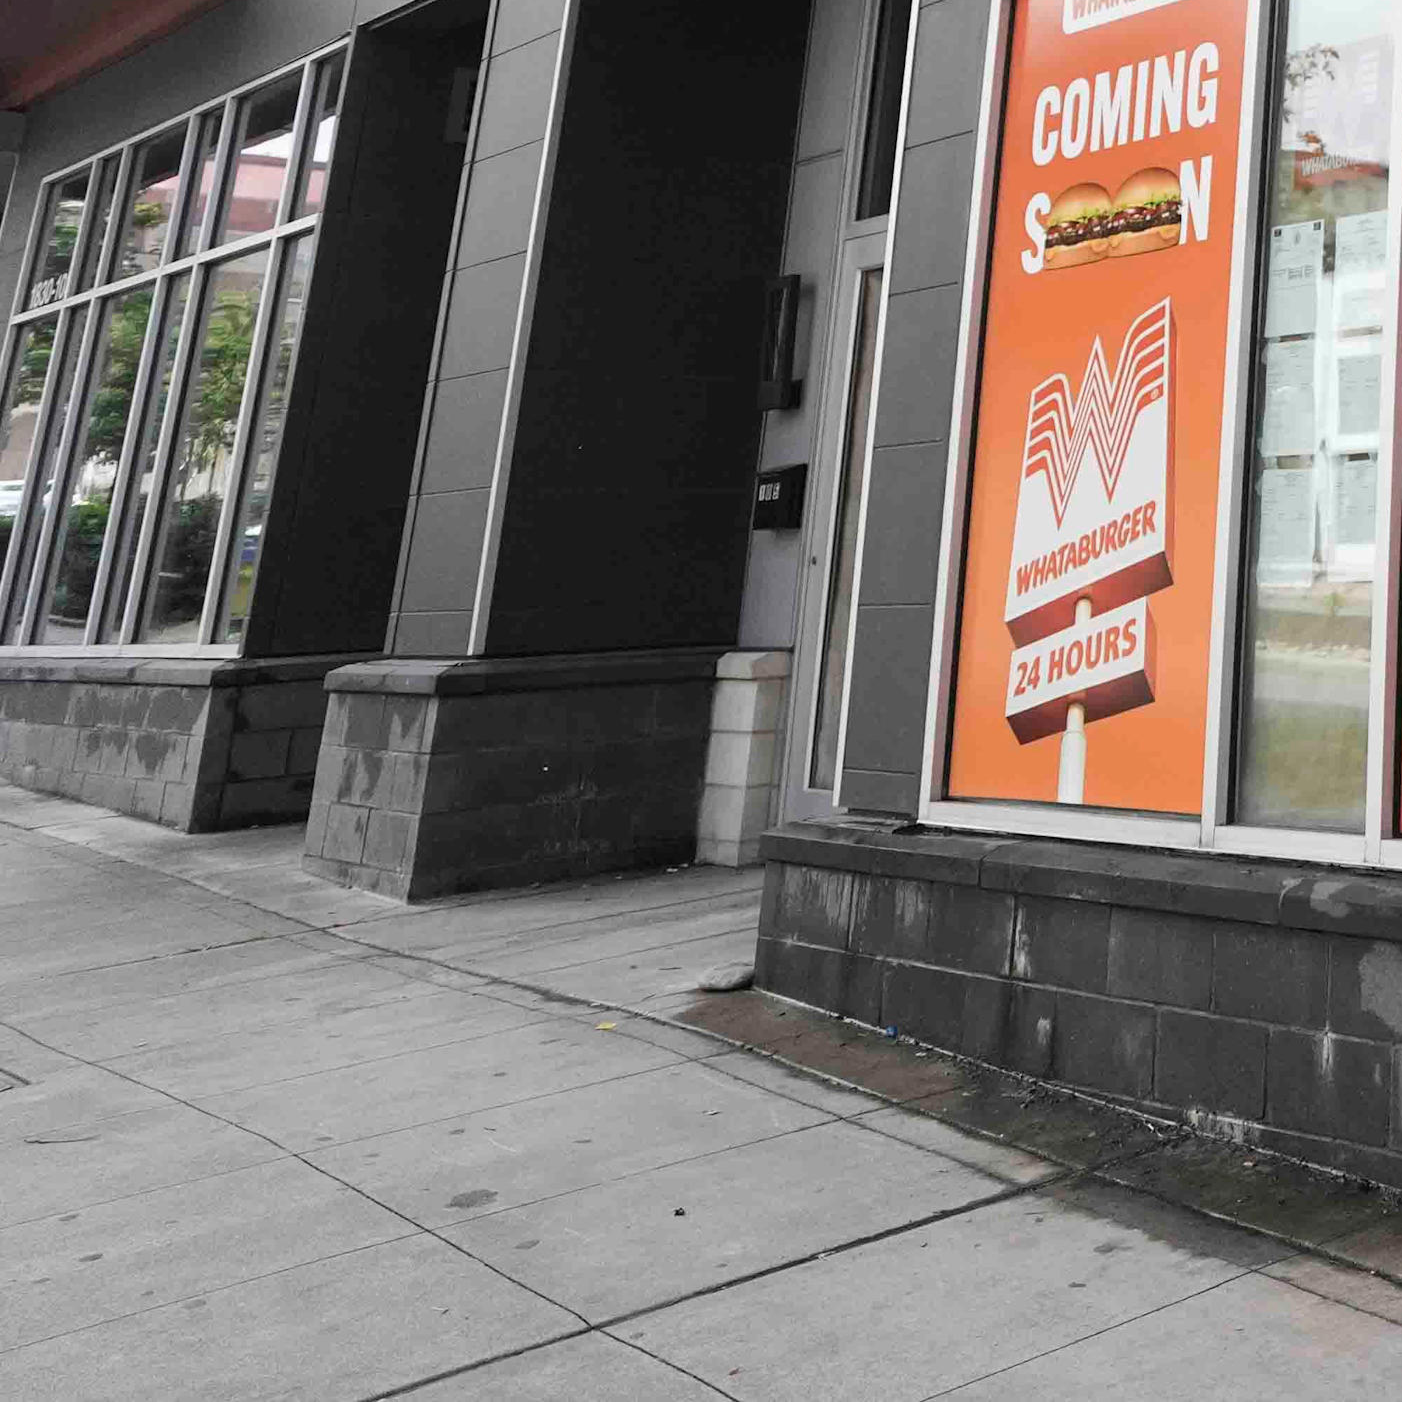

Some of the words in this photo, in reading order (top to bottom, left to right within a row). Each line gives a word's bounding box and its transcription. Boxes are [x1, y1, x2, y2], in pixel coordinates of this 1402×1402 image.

[1032, 42, 1220, 166] COMING
[1021, 154, 1214, 275] SN
[1016, 500, 1157, 597] WHATABURGER
[1013, 644, 1041, 697] 24
[1047, 616, 1138, 685] HOURS
